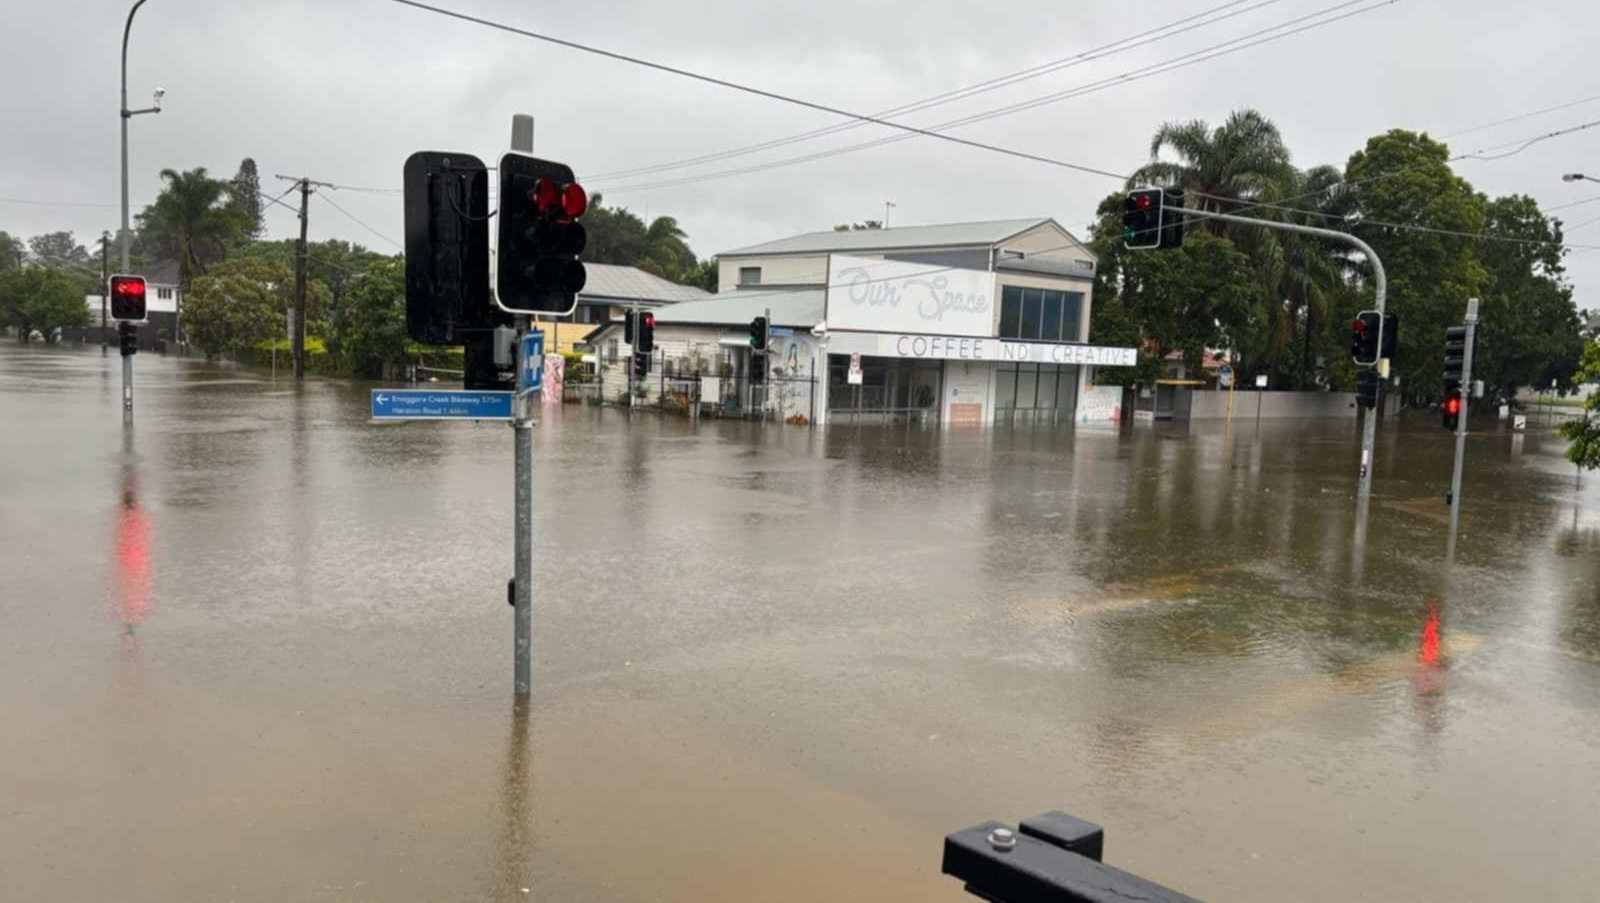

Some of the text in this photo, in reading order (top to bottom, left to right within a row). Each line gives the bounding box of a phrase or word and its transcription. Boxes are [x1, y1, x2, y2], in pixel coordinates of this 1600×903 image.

[836, 266, 989, 322] Our Space
[896, 335, 984, 359] COFFEE
[1051, 345, 1131, 366] CREATIVE
